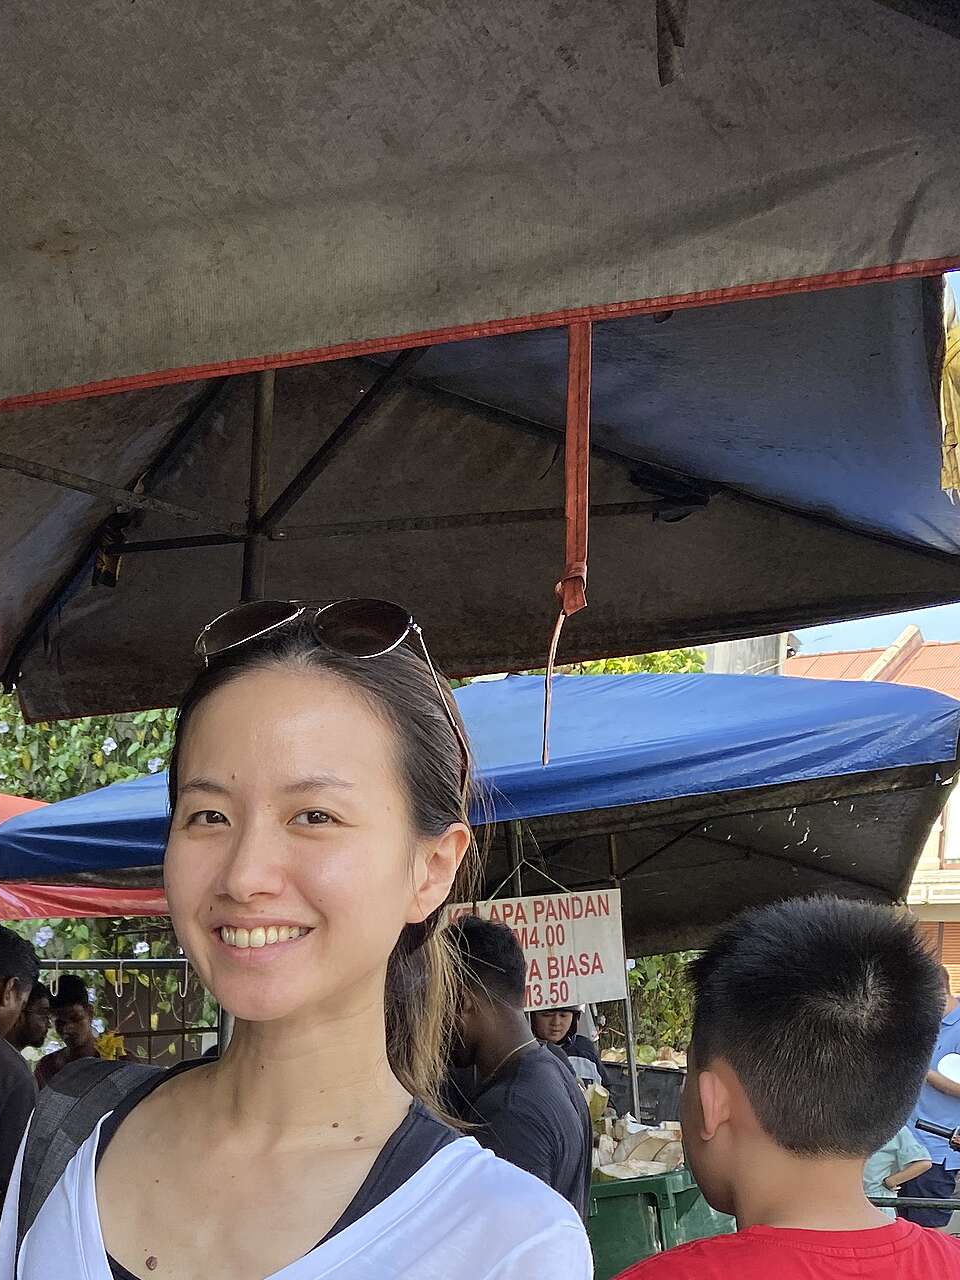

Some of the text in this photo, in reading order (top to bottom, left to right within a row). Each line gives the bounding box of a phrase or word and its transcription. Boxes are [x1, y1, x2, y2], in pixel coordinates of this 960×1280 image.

[534, 894, 610, 923] PANDAN
[512, 923, 565, 949] M4.00
[547, 952, 604, 979] BIASA
